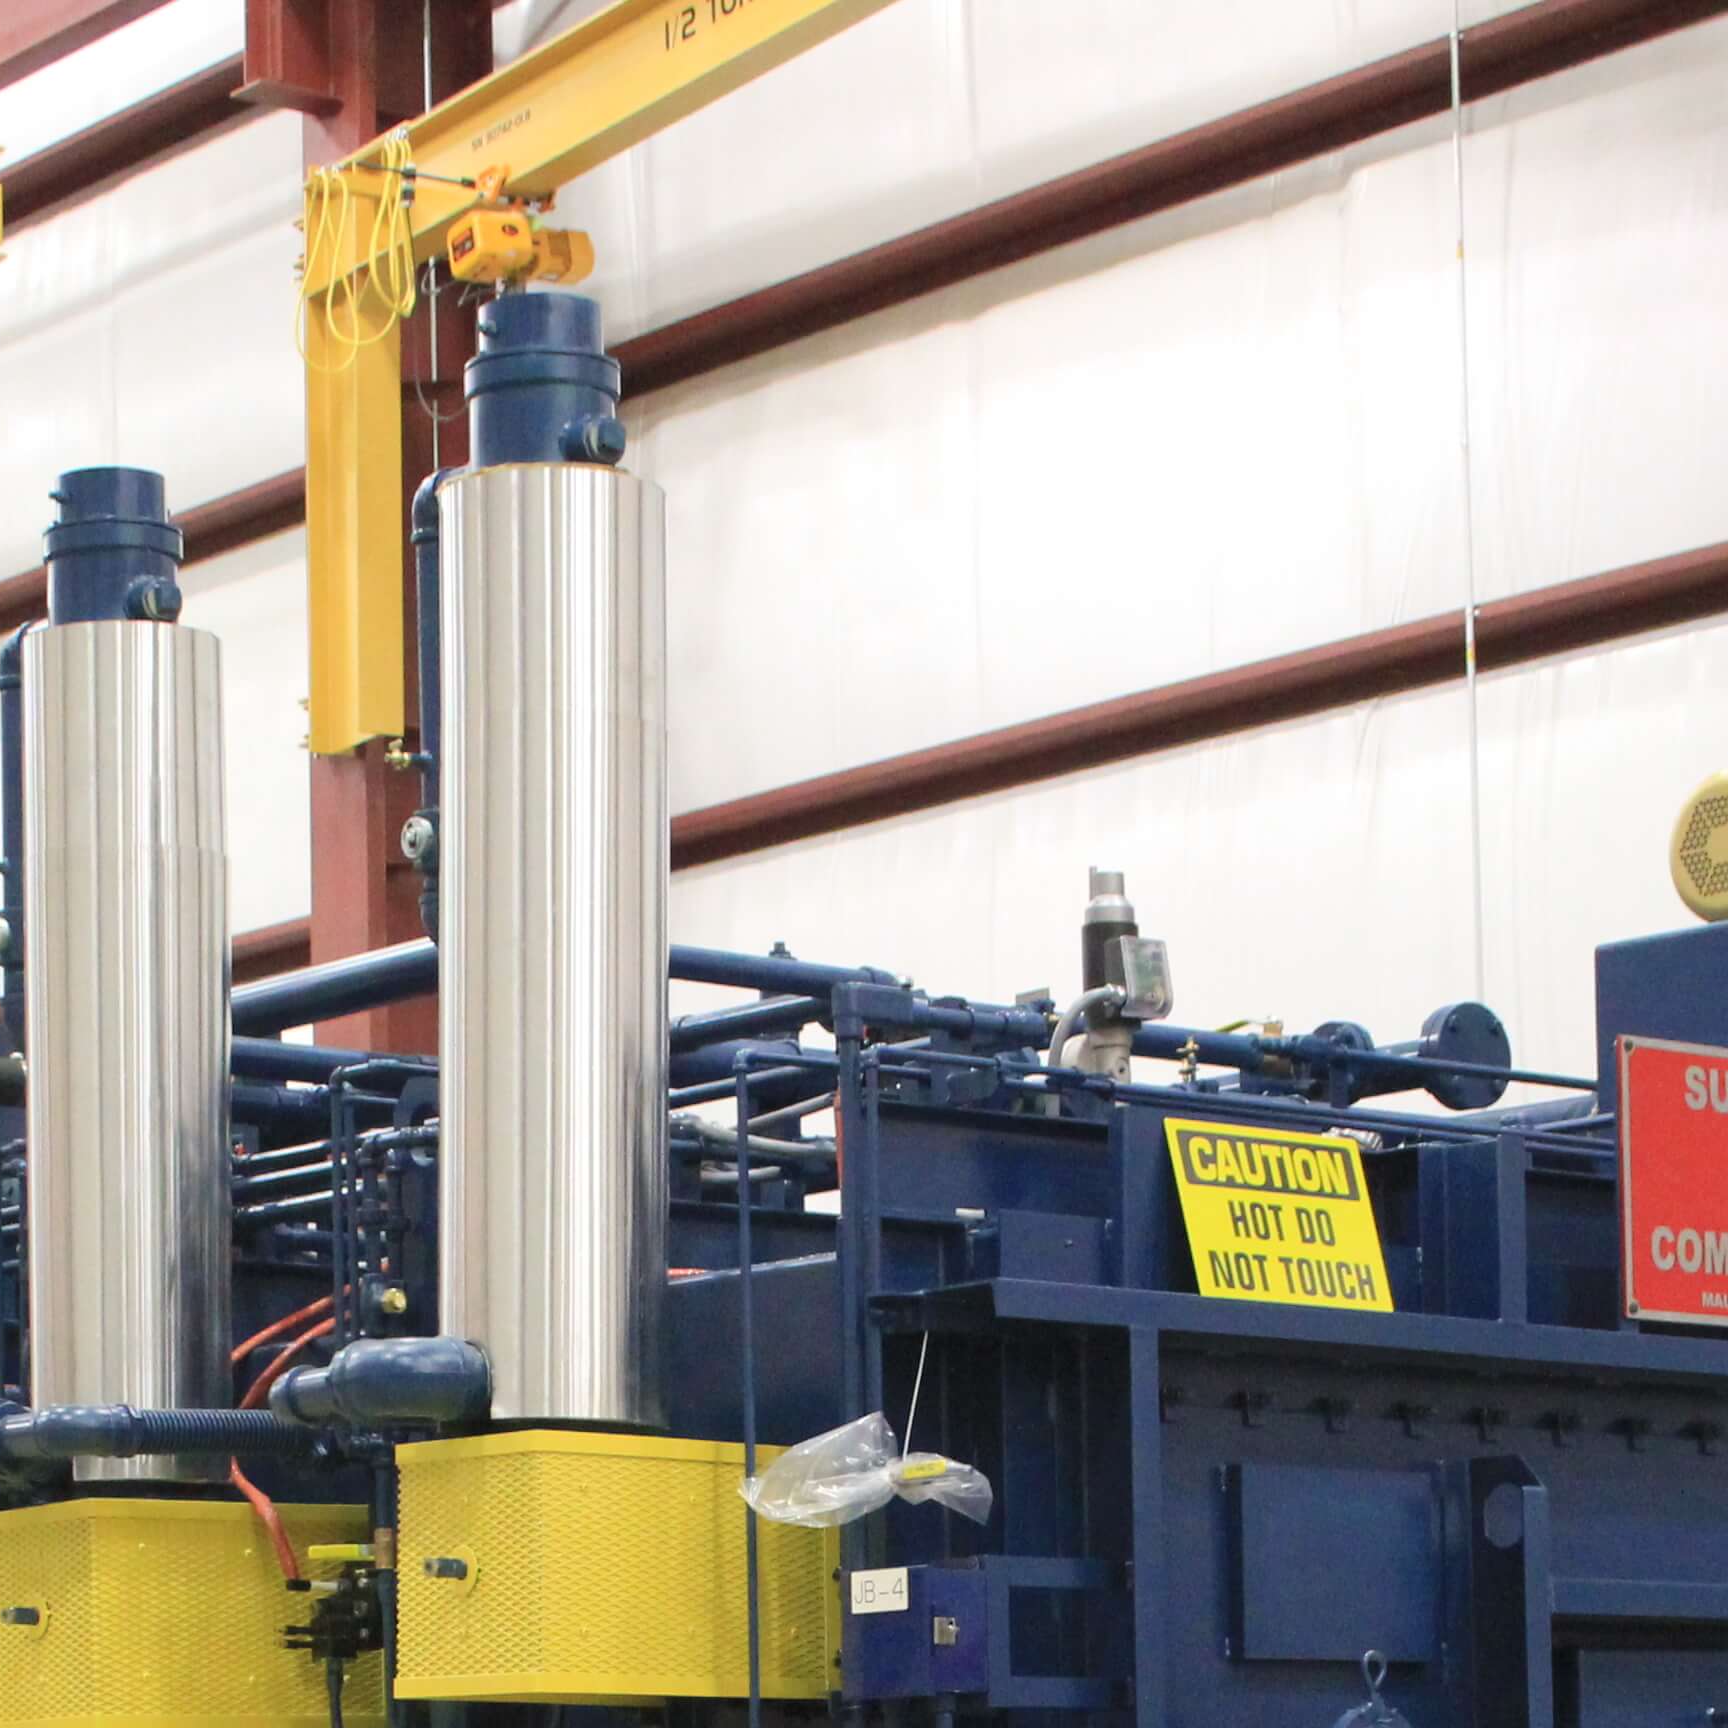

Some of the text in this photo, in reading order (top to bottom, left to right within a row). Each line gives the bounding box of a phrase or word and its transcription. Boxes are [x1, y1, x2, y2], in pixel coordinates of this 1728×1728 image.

[1187, 1135, 1351, 1196] CAUTION
[1228, 1200, 1336, 1247] HOT DO
[1208, 1250, 1377, 1302] NOT TOUCH
[854, 1577, 905, 1605] JB-4
